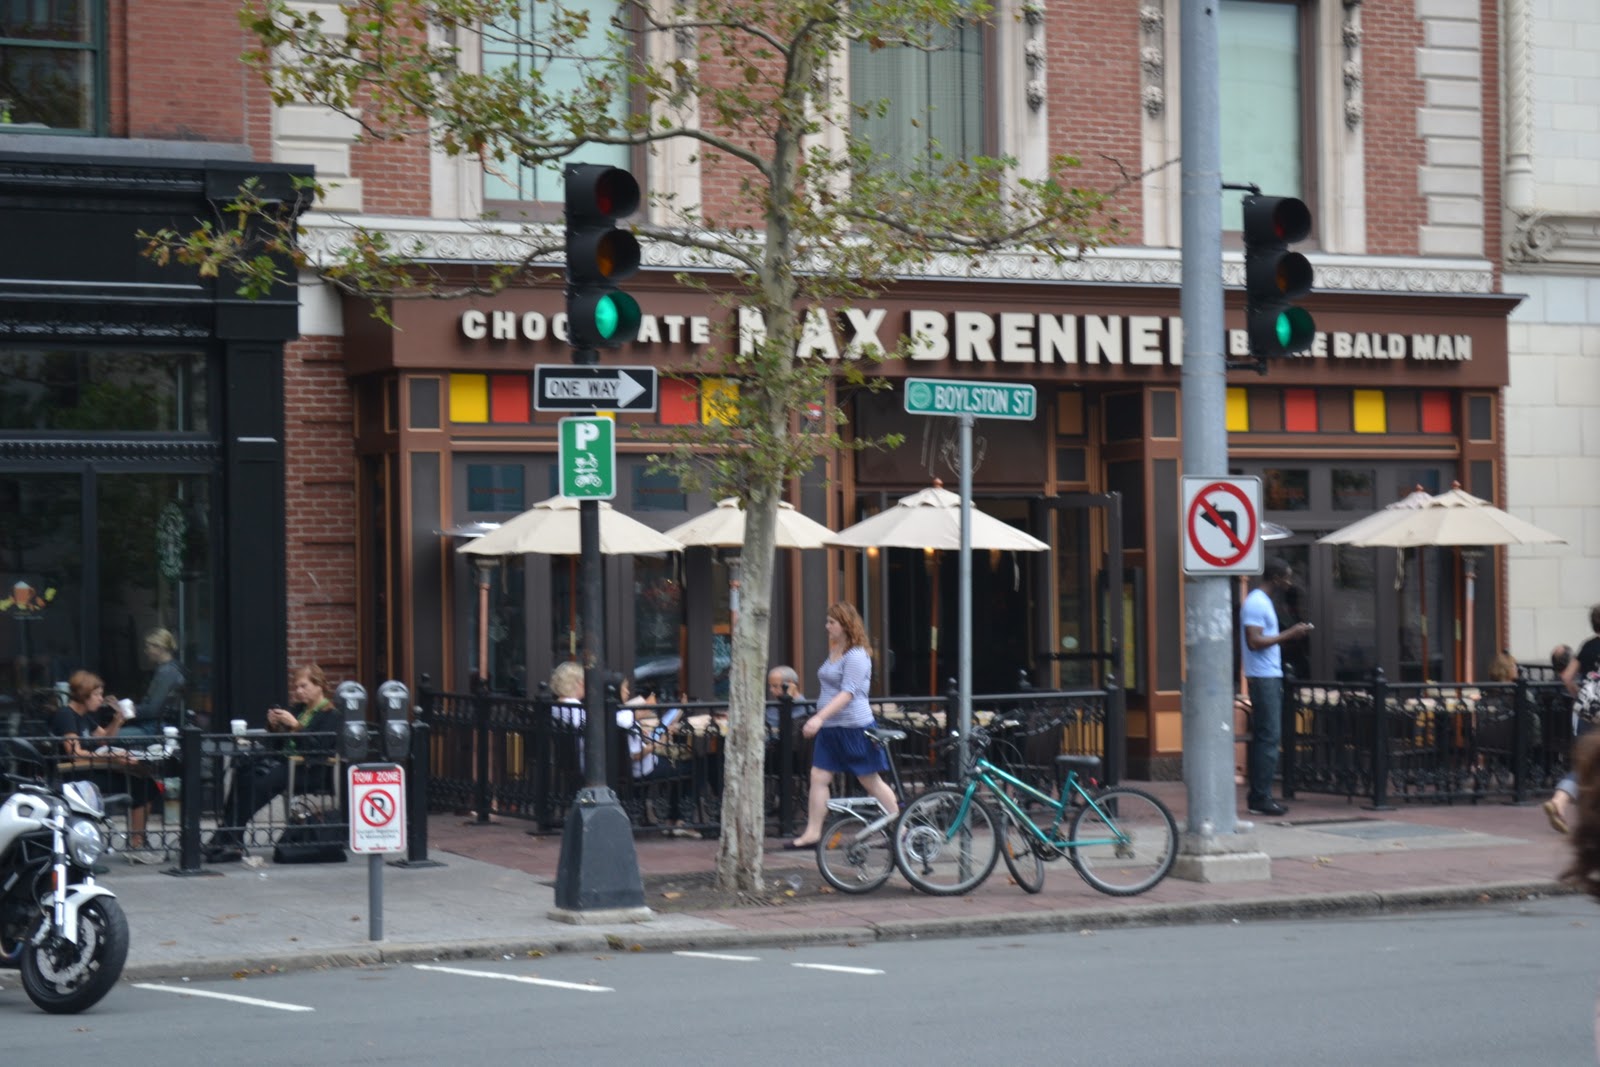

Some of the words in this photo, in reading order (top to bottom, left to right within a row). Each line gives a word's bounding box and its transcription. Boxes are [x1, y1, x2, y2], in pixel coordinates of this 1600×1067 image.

[461, 309, 710, 345] CHOCATE
[1333, 332, 1406, 360] BALD
[1413, 334, 1472, 361] MAN
[550, 380, 580, 397] ONE
[587, 380, 620, 398] WAY
[934, 385, 1008, 413] BOYLSTON
[1013, 389, 1031, 414] ST
[575, 423, 600, 451] P
[353, 771, 373, 783] TOW
[376, 771, 401, 783] ZONE
